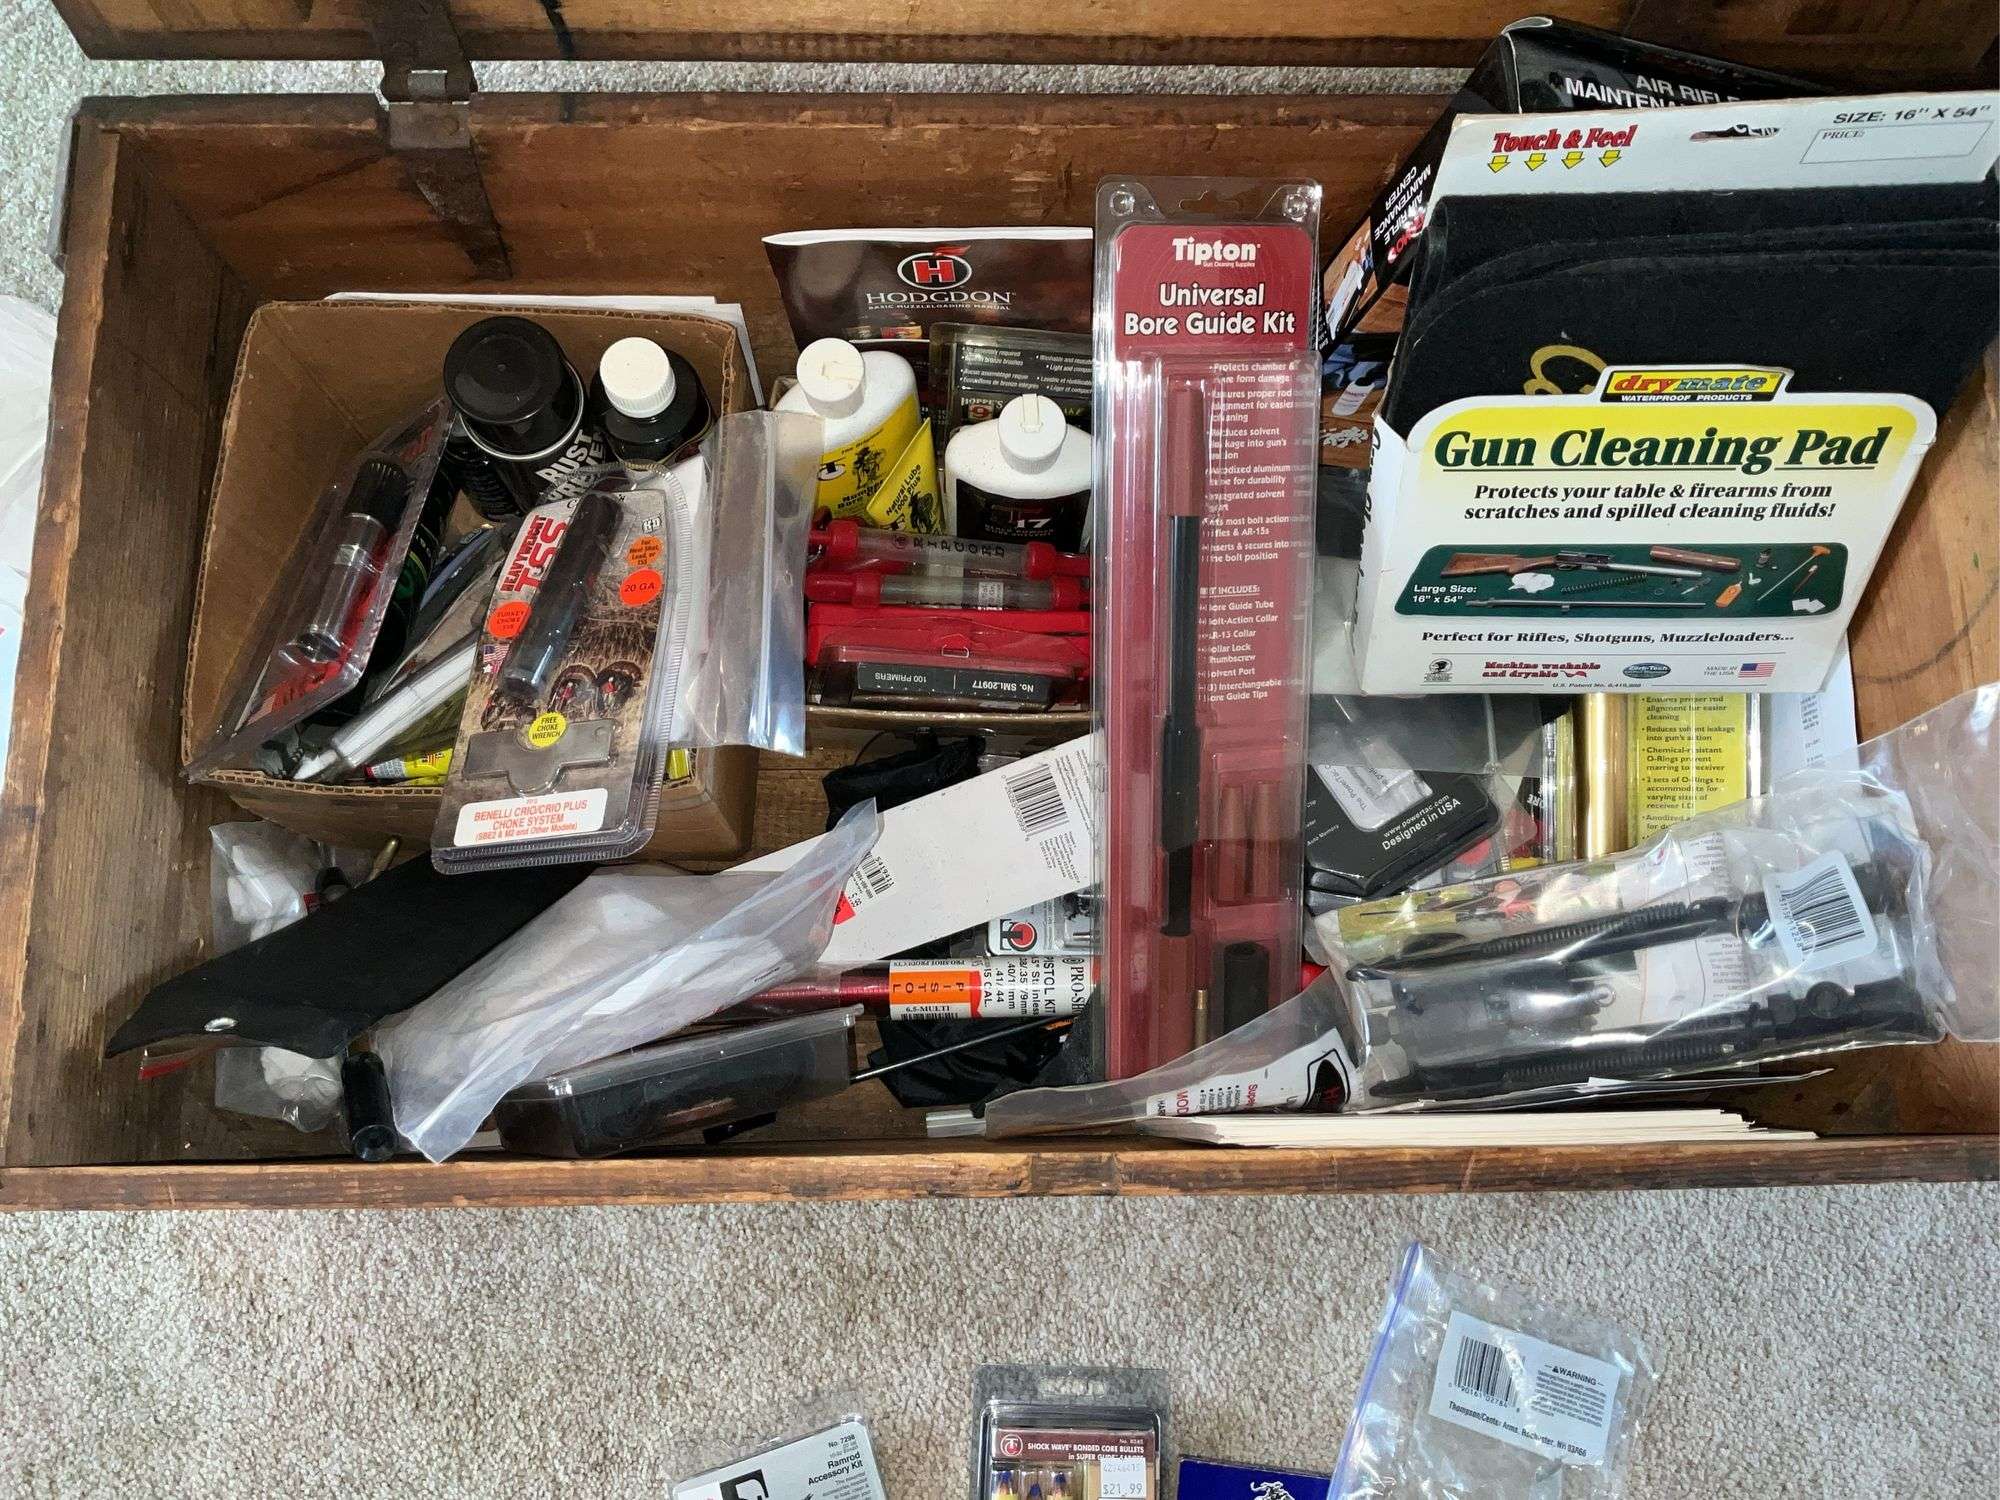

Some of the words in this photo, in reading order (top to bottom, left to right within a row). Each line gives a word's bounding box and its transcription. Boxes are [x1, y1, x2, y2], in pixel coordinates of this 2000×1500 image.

[1636, 74, 1674, 97] AIR
[1833, 111, 1886, 124] SIZE:
[1895, 108, 1929, 120] 16"
[1931, 108, 1949, 119] X
[1491, 128, 1559, 153] Touch
[1563, 130, 1583, 149] &
[1583, 124, 1639, 149] Feel
[1385, 165, 1417, 211] CENTER
[1374, 164, 1432, 241] MAINTENANCE
[1384, 212, 1410, 246] RIFLE
[1172, 236, 1257, 265] Tipton
[912, 259, 956, 283] H
[866, 291, 1011, 304] HODGDON
[1159, 282, 1265, 307] Universal
[1124, 312, 1179, 335] Bore
[1185, 311, 1256, 335] Guide
[1262, 311, 1296, 334] Kit
[1257, 374, 1290, 383] damage
[1613, 374, 1768, 394] drymate
[1247, 389, 1276, 400] proper
[1277, 389, 1293, 397] rod
[1621, 394, 1690, 402] WATERPROOF
[1696, 393, 1753, 401] PRODUCTS
[1256, 401, 1268, 409] for
[1249, 428, 1280, 436] solvent
[1266, 439, 1287, 448] gun's
[535, 428, 594, 485] RUST
[1434, 430, 1537, 467] Gun
[1549, 427, 1784, 475] Cleaning
[1783, 426, 1893, 466] Pad
[1252, 464, 1291, 472] aluminum
[1233, 477, 1246, 485] for
[1247, 476, 1286, 485] durability
[1255, 490, 1285, 498] solvent
[1474, 485, 1559, 499] Protects
[1561, 486, 1610, 502] your
[1613, 483, 1666, 498] table
[1669, 484, 1685, 497] &
[1688, 483, 1779, 498] firearms
[1780, 482, 1833, 497] from
[1464, 504, 1560, 519] scratches
[1563, 503, 1603, 518] and
[1605, 503, 1676, 521] spilled
[1679, 503, 1768, 521] cleaning
[1769, 502, 1836, 518] fluids!
[1225, 518, 1246, 526] most
[1265, 516, 1289, 524] action
[1244, 541, 1272, 550] secures
[514, 518, 567, 592] TSS
[1244, 552, 1279, 562] position
[624, 583, 637, 593] 20
[639, 582, 655, 590] GA
[1413, 584, 1447, 594] Large
[1449, 584, 1478, 593] Size:
[1228, 602, 1253, 610] Guide
[1254, 601, 1274, 609] Tube
[1255, 614, 1279, 623] Collar
[1233, 629, 1257, 638] Collar
[1421, 631, 1484, 642] Perfect
[1487, 632, 1513, 642] for
[1516, 632, 1570, 644] Rifles,
[1573, 632, 1656, 644] Shotguns,
[1659, 631, 1795, 643] Muzzleloaders...
[1231, 643, 1251, 651] Lock
[874, 672, 910, 683] PRIMERS
[1238, 667, 1256, 676] Port
[910, 675, 927, 684] 100
[1252, 690, 1268, 699] Tips
[540, 716, 558, 724] FREE
[536, 724, 559, 732] CHOKE
[532, 730, 562, 740] WRENCH
[474, 808, 513, 821] BENELLI
[563, 799, 589, 811] PLUS
[1383, 793, 1450, 838] www.powertac.com
[492, 819, 525, 831] CHOKE
[526, 813, 565, 826] SYSTEM
[1381, 818, 1429, 851] Designed
[1439, 797, 1461, 819] USA
[1070, 966, 1086, 1015] PRO-SH
[1045, 998, 1056, 1014] KIT
[1559, 1366, 1597, 1386] WARNING
[1027, 1442, 1050, 1450] SHOCK
[1073, 1444, 1100, 1452] BONDED
[827, 1450, 861, 1469] Ramrod
[808, 1465, 850, 1486] Accessory
[851, 1459, 863, 1470] Kit
[1102, 1482, 1143, 1495] $21.99
